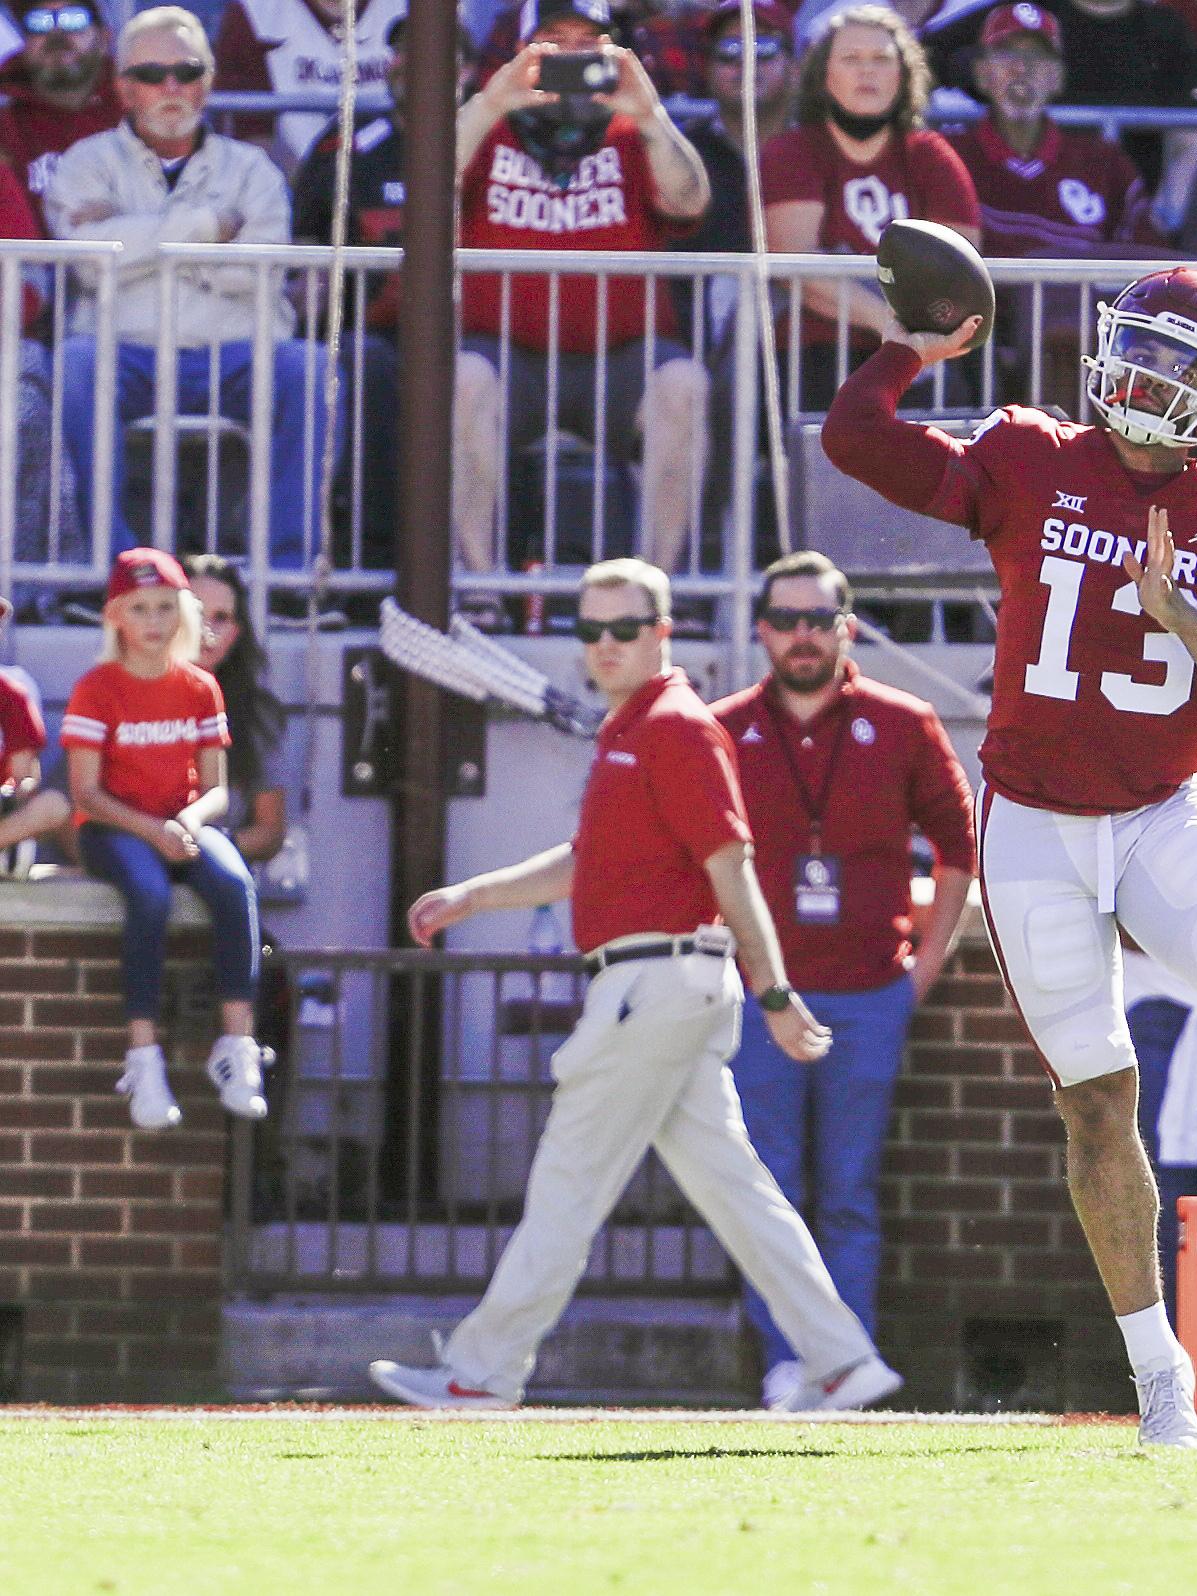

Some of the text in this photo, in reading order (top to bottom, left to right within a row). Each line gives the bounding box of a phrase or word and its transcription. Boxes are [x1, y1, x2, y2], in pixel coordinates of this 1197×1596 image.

[490, 145, 623, 192] BOER
[488, 184, 626, 232] SOONER
[1051, 490, 1088, 514] XII
